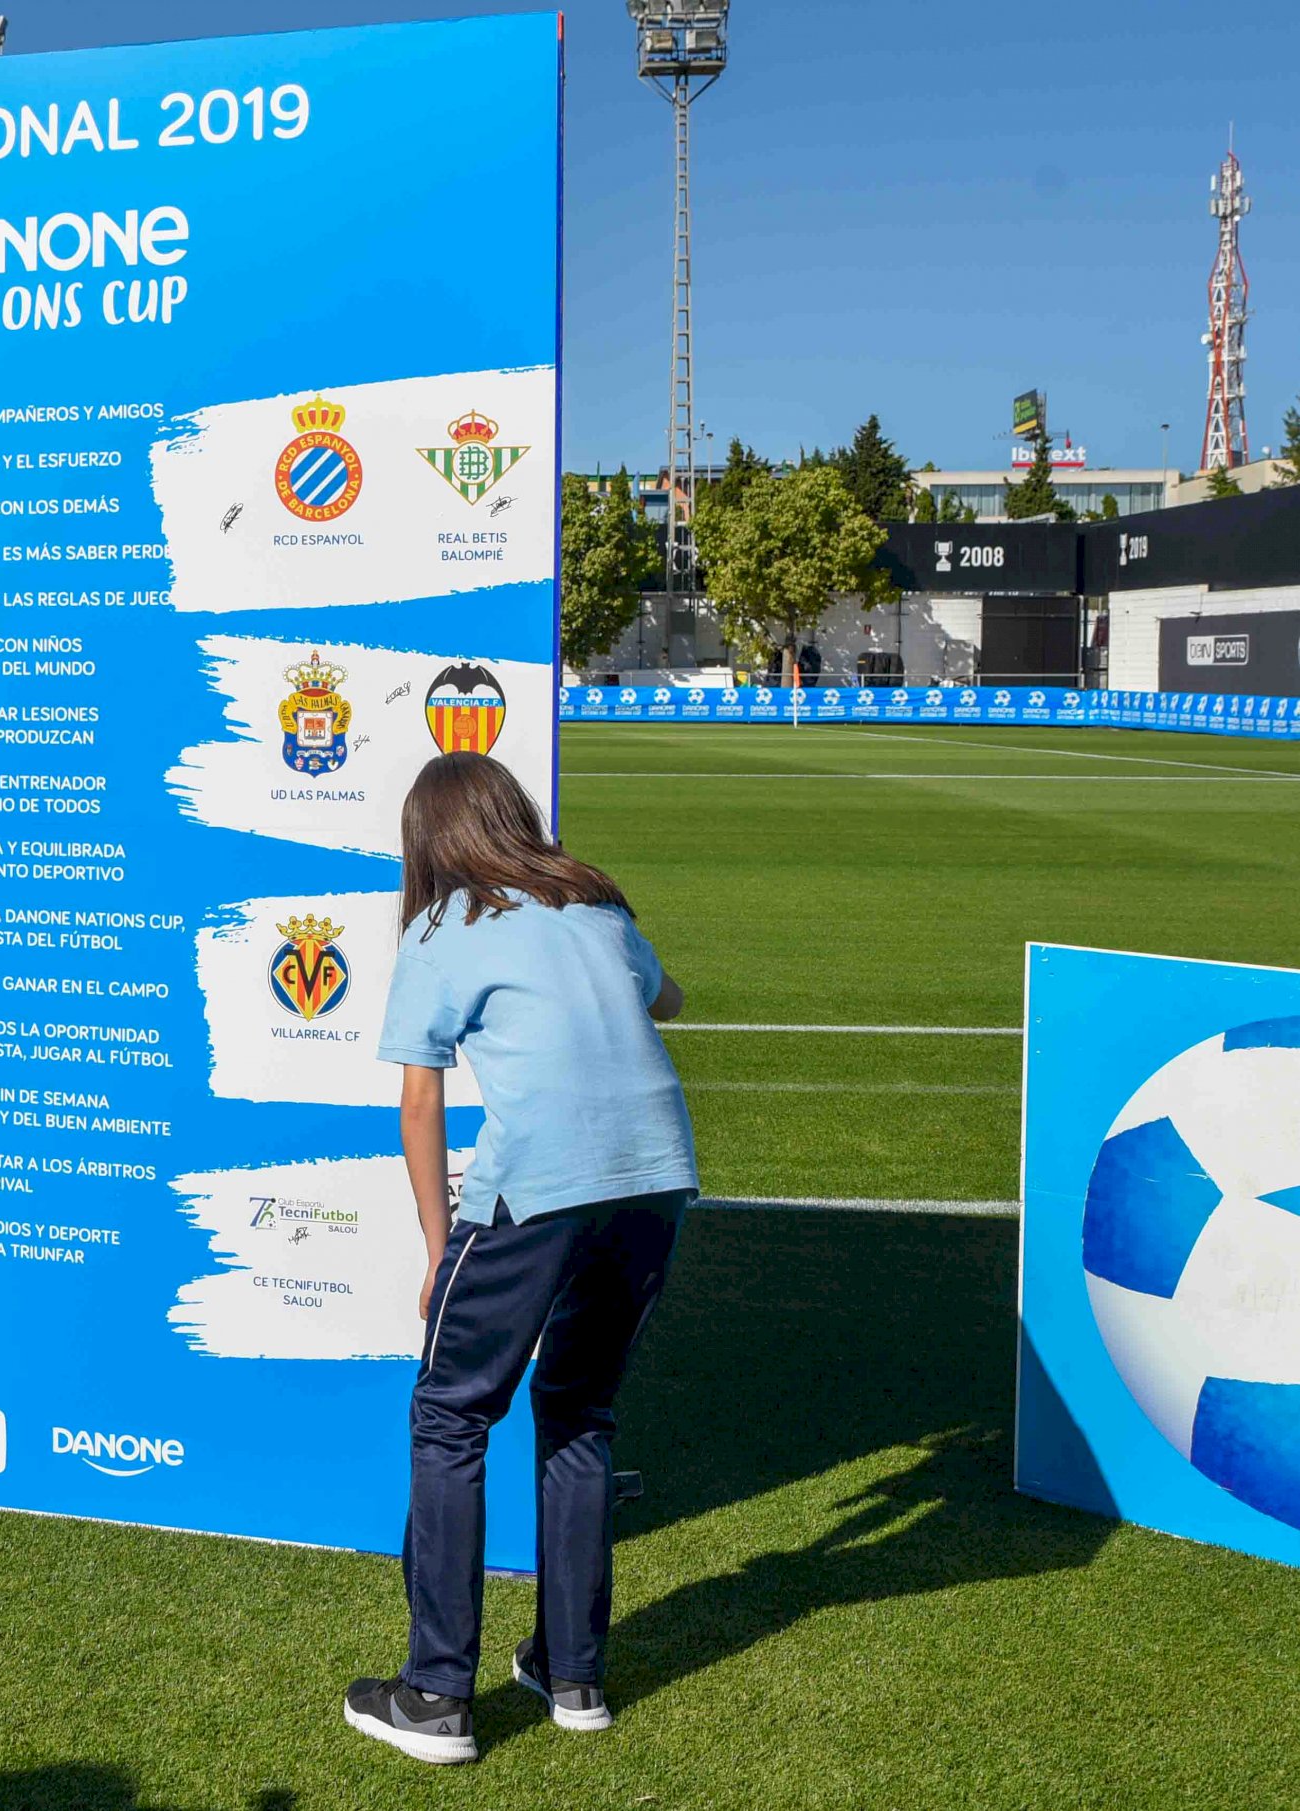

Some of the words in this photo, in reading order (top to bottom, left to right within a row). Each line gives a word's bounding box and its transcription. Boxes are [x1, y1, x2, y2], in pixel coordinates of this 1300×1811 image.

[158, 83, 310, 148] 2019
[103, 276, 188, 326] CUP
[84, 406, 94, 420] Y
[98, 403, 164, 422] AMIGOS
[279, 446, 298, 472] RCD
[300, 434, 358, 471] ESPANYOL
[1011, 446, 1086, 461] Ibext
[278, 481, 291, 498] DE
[288, 480, 359, 519] BARCELONA
[273, 534, 298, 546] RCD
[301, 534, 364, 546] ESPANYOL
[437, 532, 469, 544] REAL
[472, 532, 507, 543] BETIS
[3, 546, 22, 561] ES
[26, 543, 62, 560] MÁS
[66, 545, 118, 560] SABER
[441, 547, 504, 561] BALOMPIÉ
[959, 546, 1004, 567] 2008
[1128, 536, 1148, 560] 2019
[4, 592, 34, 607] LAS
[38, 592, 100, 606] REGLAS
[105, 591, 125, 606] DE
[1215, 641, 1246, 659] SPORTS
[432, 698, 480, 706] VALENCIA
[22, 706, 99, 722] LESIONES
[270, 788, 287, 800] UD
[290, 789, 313, 801] LAS
[316, 789, 365, 802] PALMAS
[8, 842, 17, 855] Y
[22, 841, 126, 858] EQUILIBRADA
[6, 909, 71, 925] DANONE
[76, 912, 146, 928] NATIONS
[150, 914, 185, 932] CUP,
[270, 1028, 342, 1041] VILLARREAL
[344, 1031, 360, 1042] CF
[30, 1046, 82, 1062] JUGAR
[86, 1049, 106, 1064] AL
[110, 1047, 173, 1068] FÚTBOL
[0, 1110, 9, 1124] Y
[13, 1111, 41, 1127] DEL
[46, 1114, 87, 1130] BUEN
[91, 1118, 171, 1136] AMBIENTE
[278, 1197, 294, 1206] Club
[296, 1199, 324, 1209] Esportiu
[279, 1205, 358, 1222] TecniFutbol
[35, 1224, 45, 1237] Y
[49, 1225, 120, 1245] DEPORTE
[328, 1225, 358, 1234] SALOU
[253, 1276, 269, 1288] CE
[272, 1277, 353, 1295] TECNIFUTBOL
[283, 1294, 323, 1308] SALOU
[52, 1427, 185, 1467] DANONE
